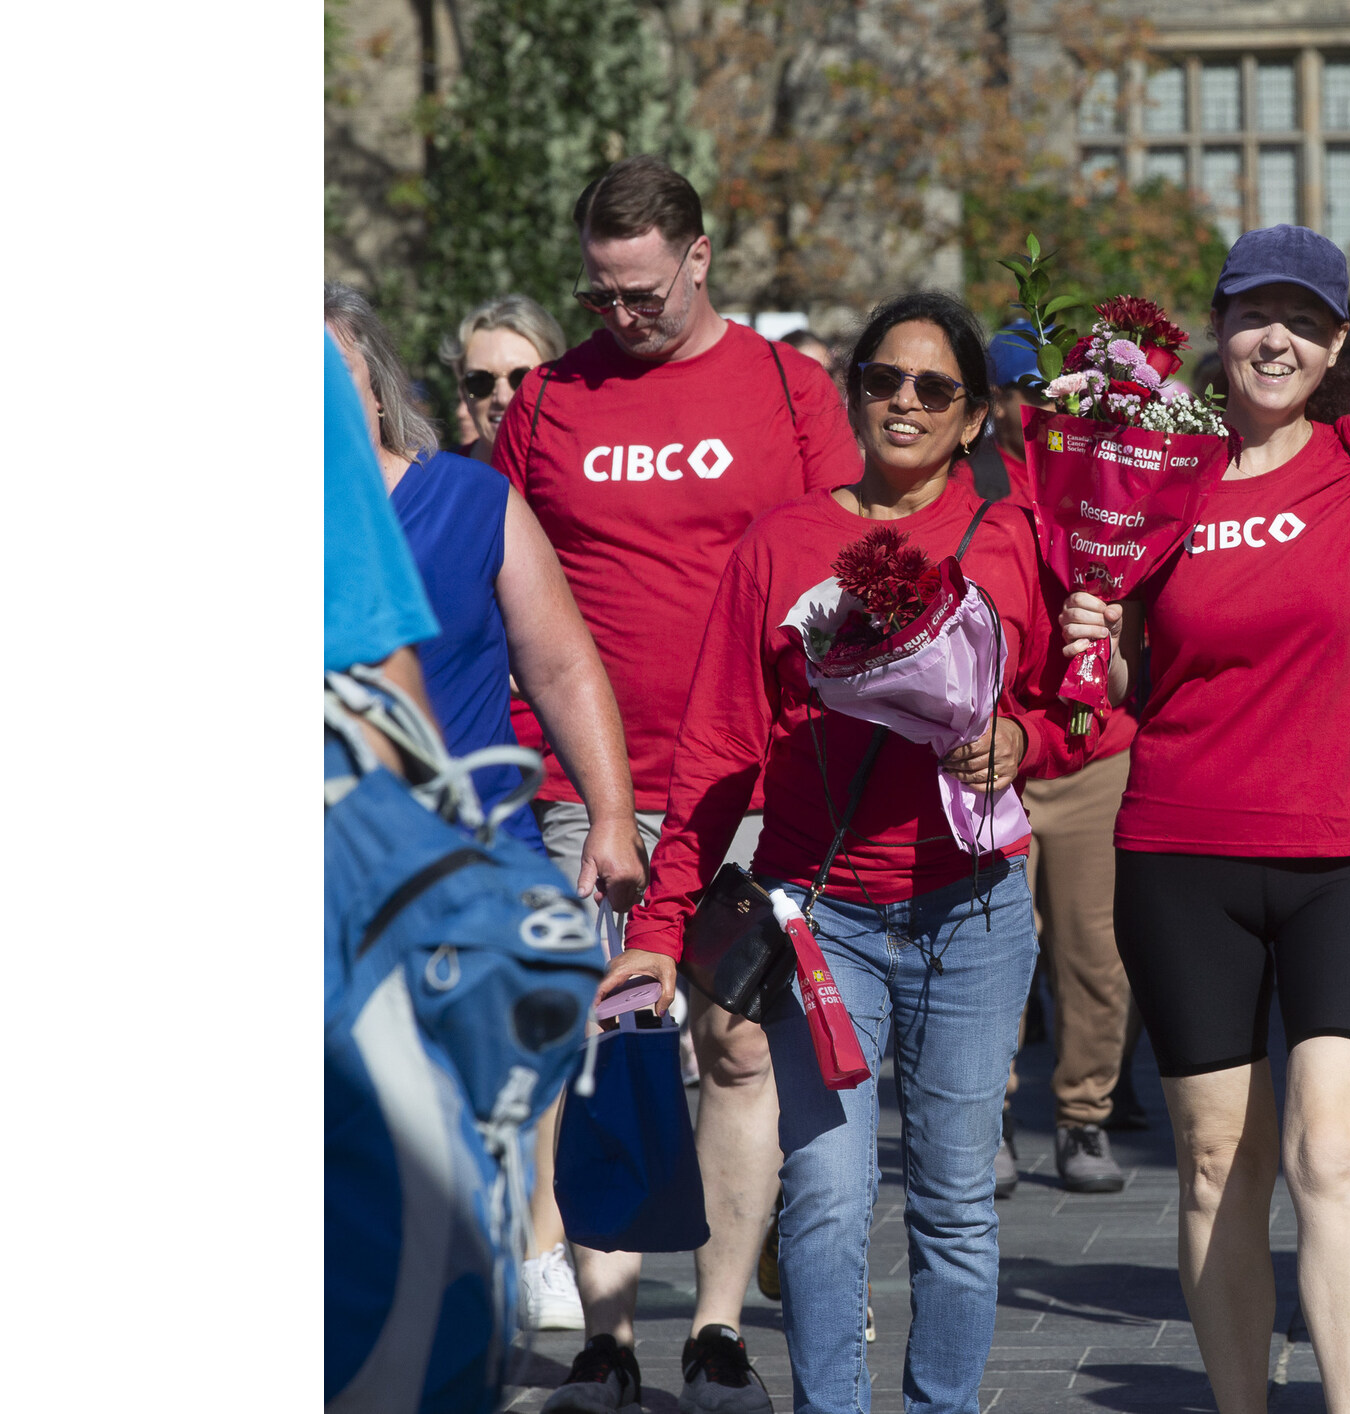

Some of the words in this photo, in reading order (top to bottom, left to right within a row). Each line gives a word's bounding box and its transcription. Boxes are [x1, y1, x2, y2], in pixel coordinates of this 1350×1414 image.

[583, 443, 684, 482] CIBC
[1097, 450, 1118, 463] FOR
[1117, 455, 1134, 466] THE
[1133, 459, 1162, 471] CURE
[1100, 440, 1123, 454] CIBC
[1134, 447, 1163, 462] RUN
[1170, 456, 1191, 468] CIBC
[1080, 500, 1145, 528] Research
[1070, 532, 1147, 561] Community
[1183, 516, 1267, 555] CIBC
[931, 603, 950, 626] CIBC
[864, 652, 894, 668] CIBC
[903, 629, 929, 652] RUN
